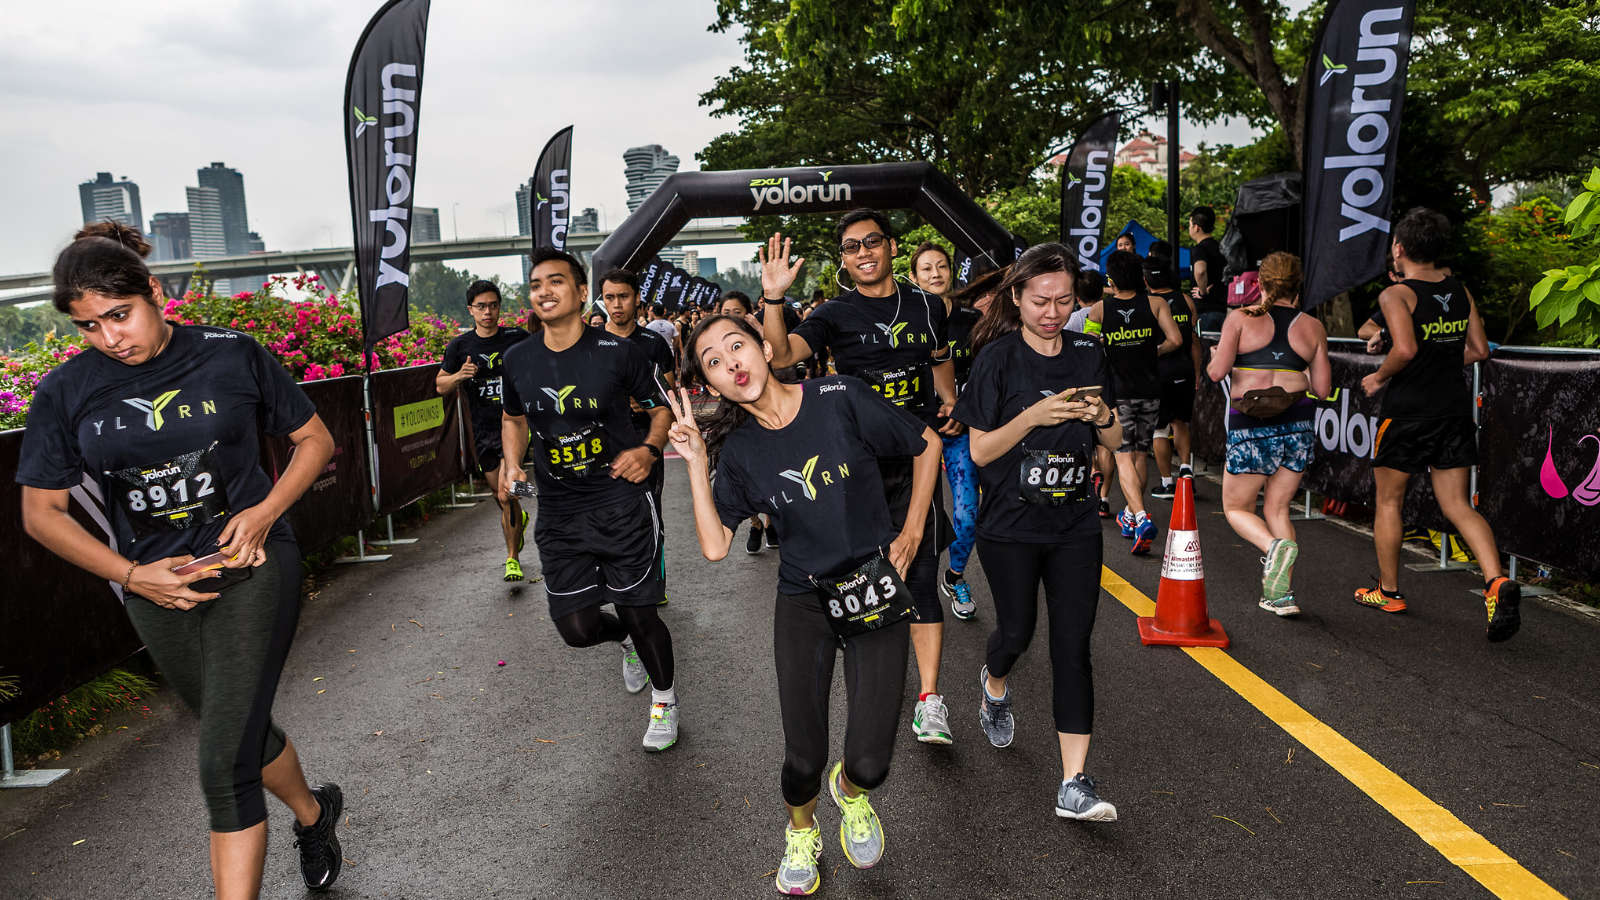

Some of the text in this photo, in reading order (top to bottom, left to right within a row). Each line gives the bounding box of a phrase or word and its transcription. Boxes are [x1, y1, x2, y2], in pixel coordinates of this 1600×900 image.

[1324, 7, 1403, 242] yolorun
[369, 62, 416, 290] yolorun
[550, 169, 569, 252] orun
[750, 177, 852, 211] yolorun
[1070, 150, 1109, 272] yolorun
[1105, 326, 1152, 345] yolorun
[1420, 316, 1468, 340] yoloru
[550, 438, 602, 464] 3518
[141, 465, 181, 483] yolorun
[1028, 466, 1085, 485] 8045
[128, 472, 215, 511] 8912
[828, 576, 897, 618] 8043
[837, 574, 867, 594] yolorun
